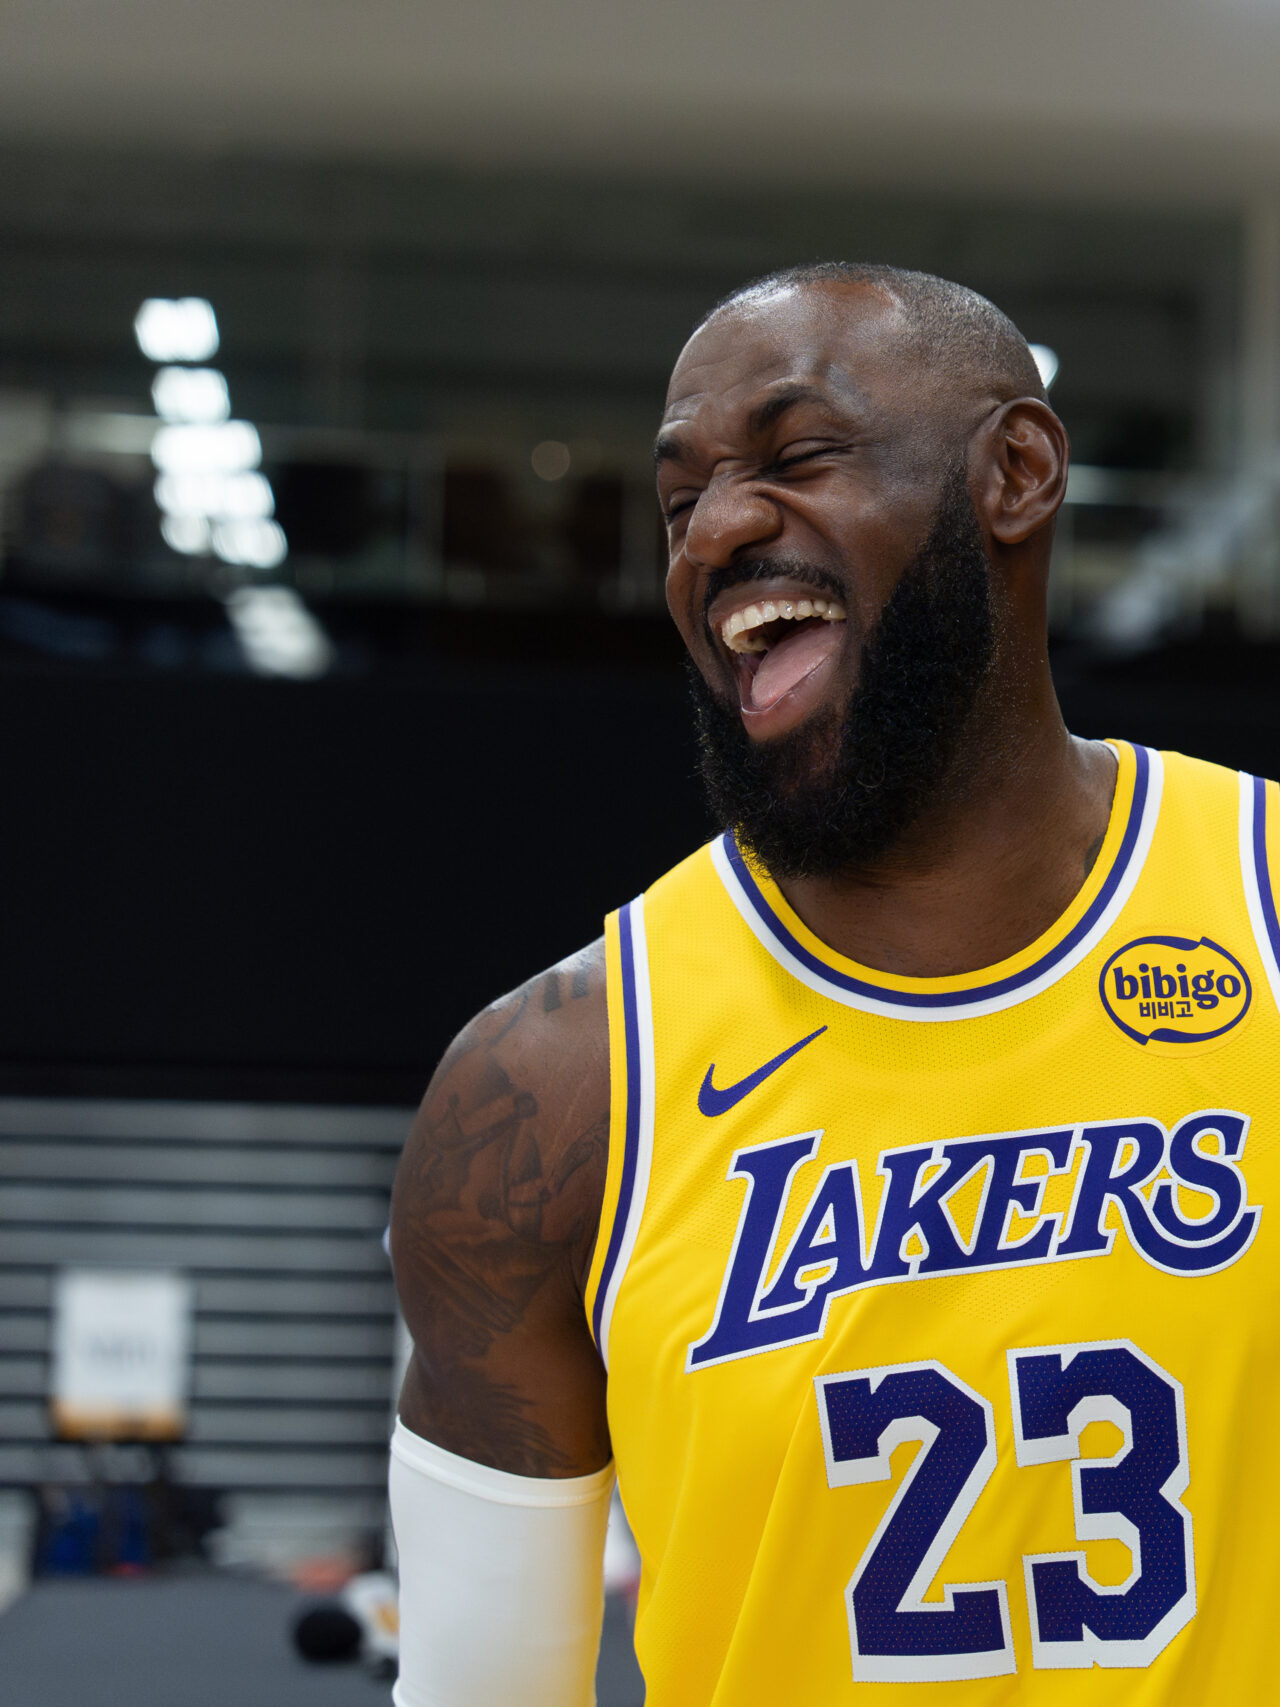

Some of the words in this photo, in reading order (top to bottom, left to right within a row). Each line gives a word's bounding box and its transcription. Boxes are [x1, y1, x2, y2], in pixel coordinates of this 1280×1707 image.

[1113, 963, 1241, 1010] bibigo
[1139, 1001, 1194, 1019] 비비고
[685, 1108, 1263, 1373] LAKERS
[814, 1338, 1198, 1683] 23
